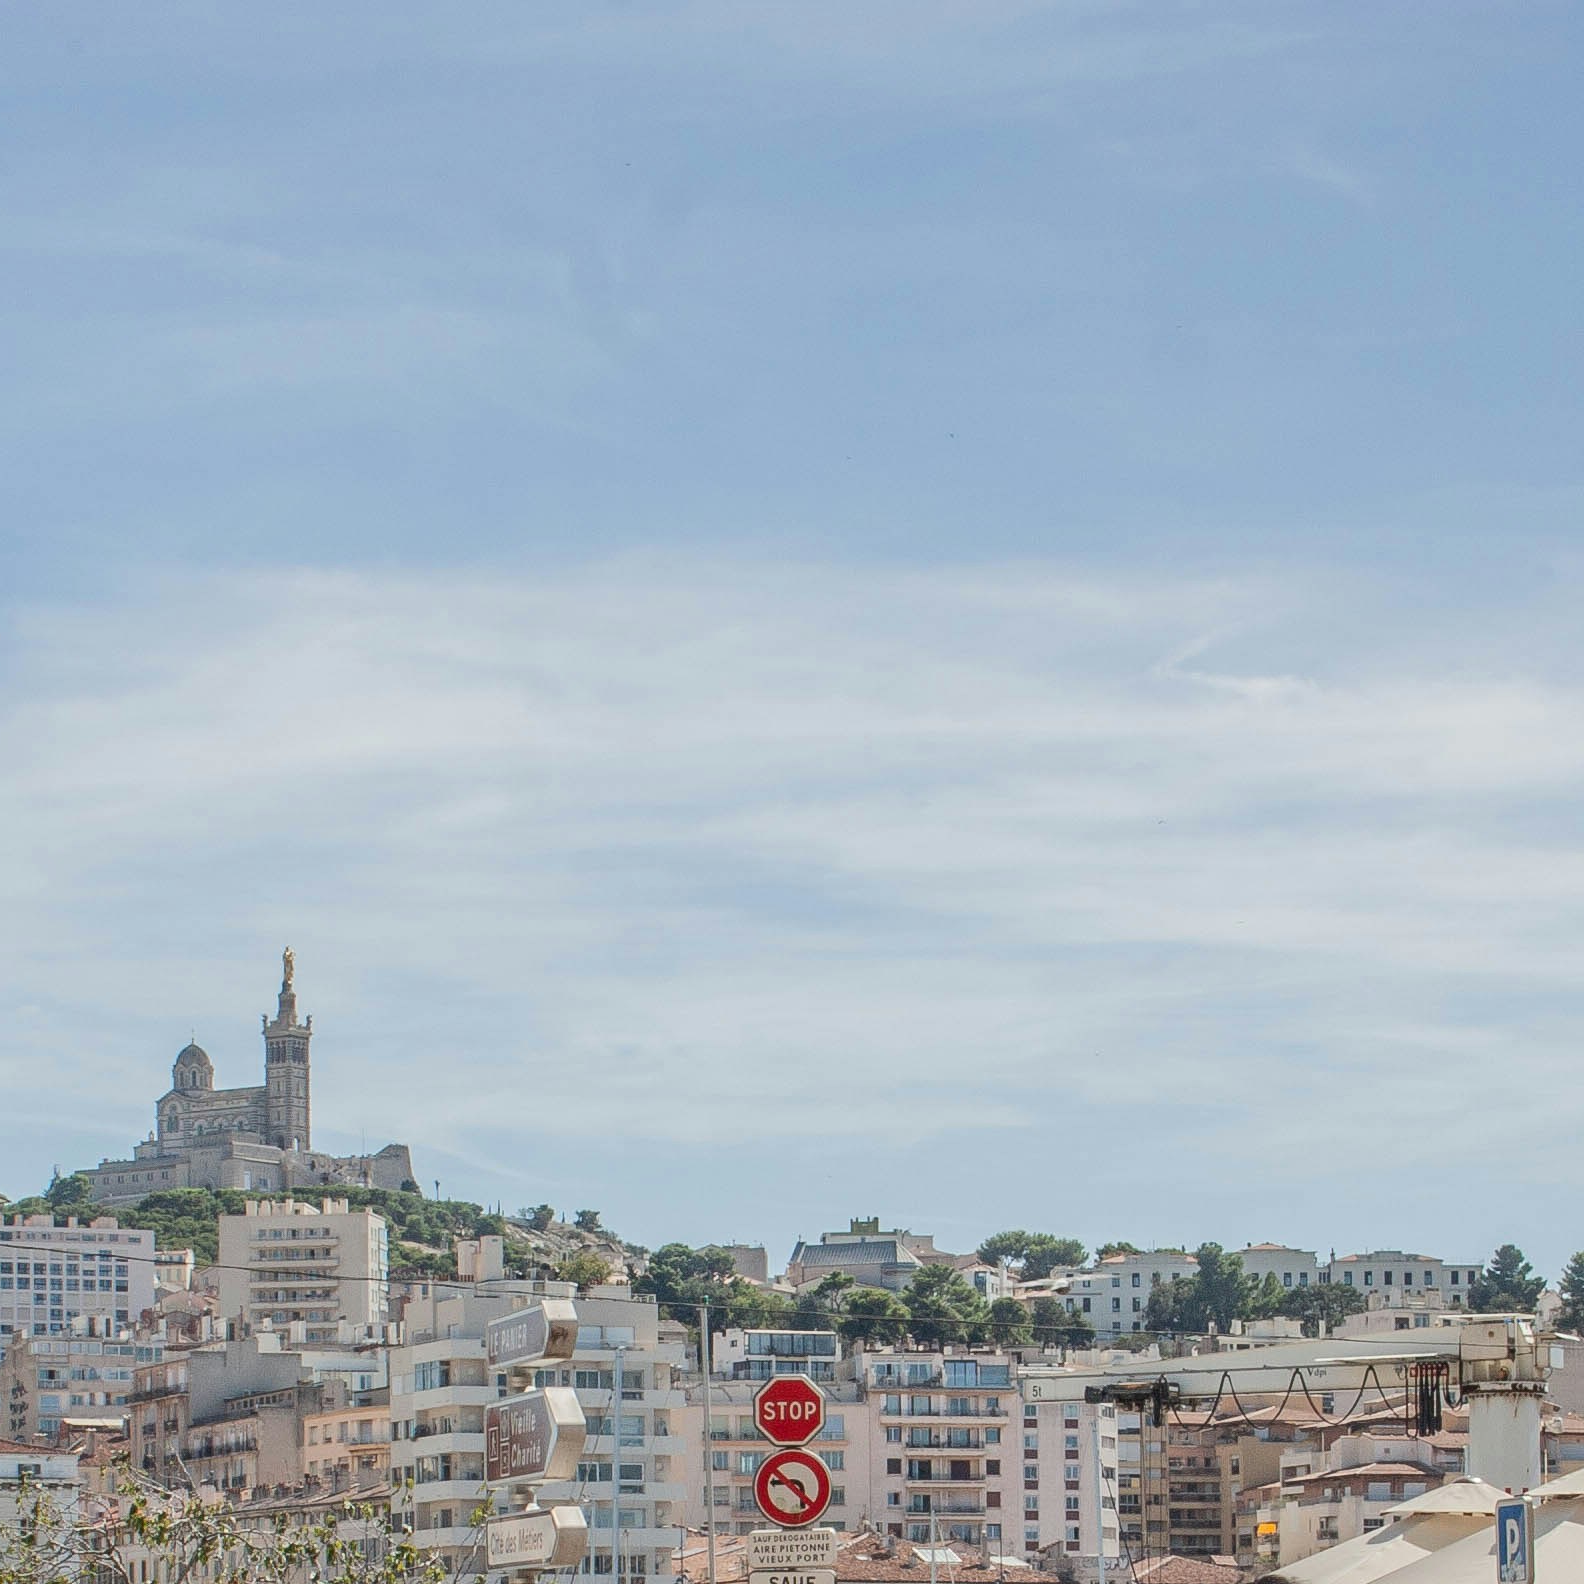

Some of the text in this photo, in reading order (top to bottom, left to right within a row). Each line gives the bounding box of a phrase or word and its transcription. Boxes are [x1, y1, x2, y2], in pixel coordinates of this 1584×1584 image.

[490, 1323, 527, 1357] LE PANIER
[763, 1401, 817, 1420] STOP
[510, 1408, 537, 1437] Vieille
[511, 1439, 542, 1468] Charité
[490, 1531, 505, 1556] Cité
[505, 1533, 517, 1554] des
[753, 1533, 830, 1543] SAUF DEROGATAIRES
[753, 1546, 776, 1554] AIRE
[758, 1554, 826, 1563] VIEUX PORT
